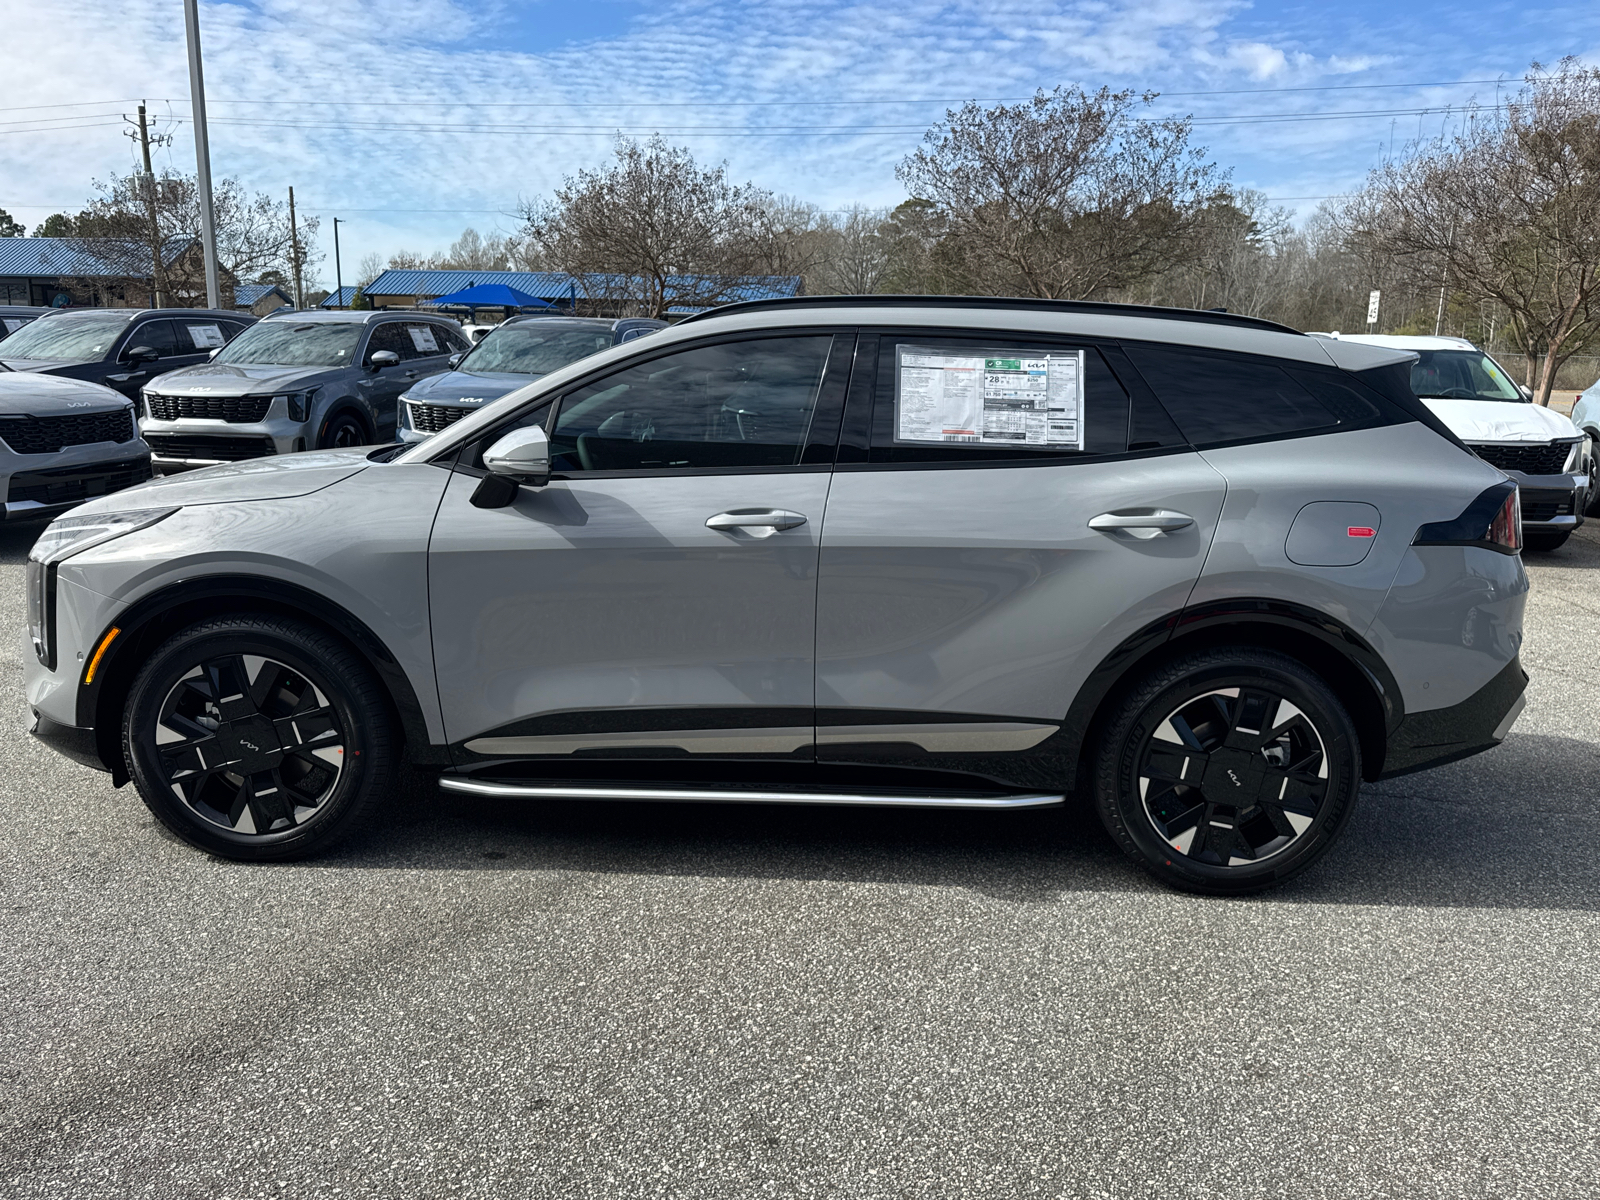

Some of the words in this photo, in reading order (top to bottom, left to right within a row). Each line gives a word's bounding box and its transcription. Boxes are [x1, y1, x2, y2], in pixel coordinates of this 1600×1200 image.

[239, 739, 260, 752] KIA
[1121, 724, 1145, 793] MICHELIN
[1226, 769, 1242, 787] KIA
[1324, 766, 1350, 835] MICHELIN
